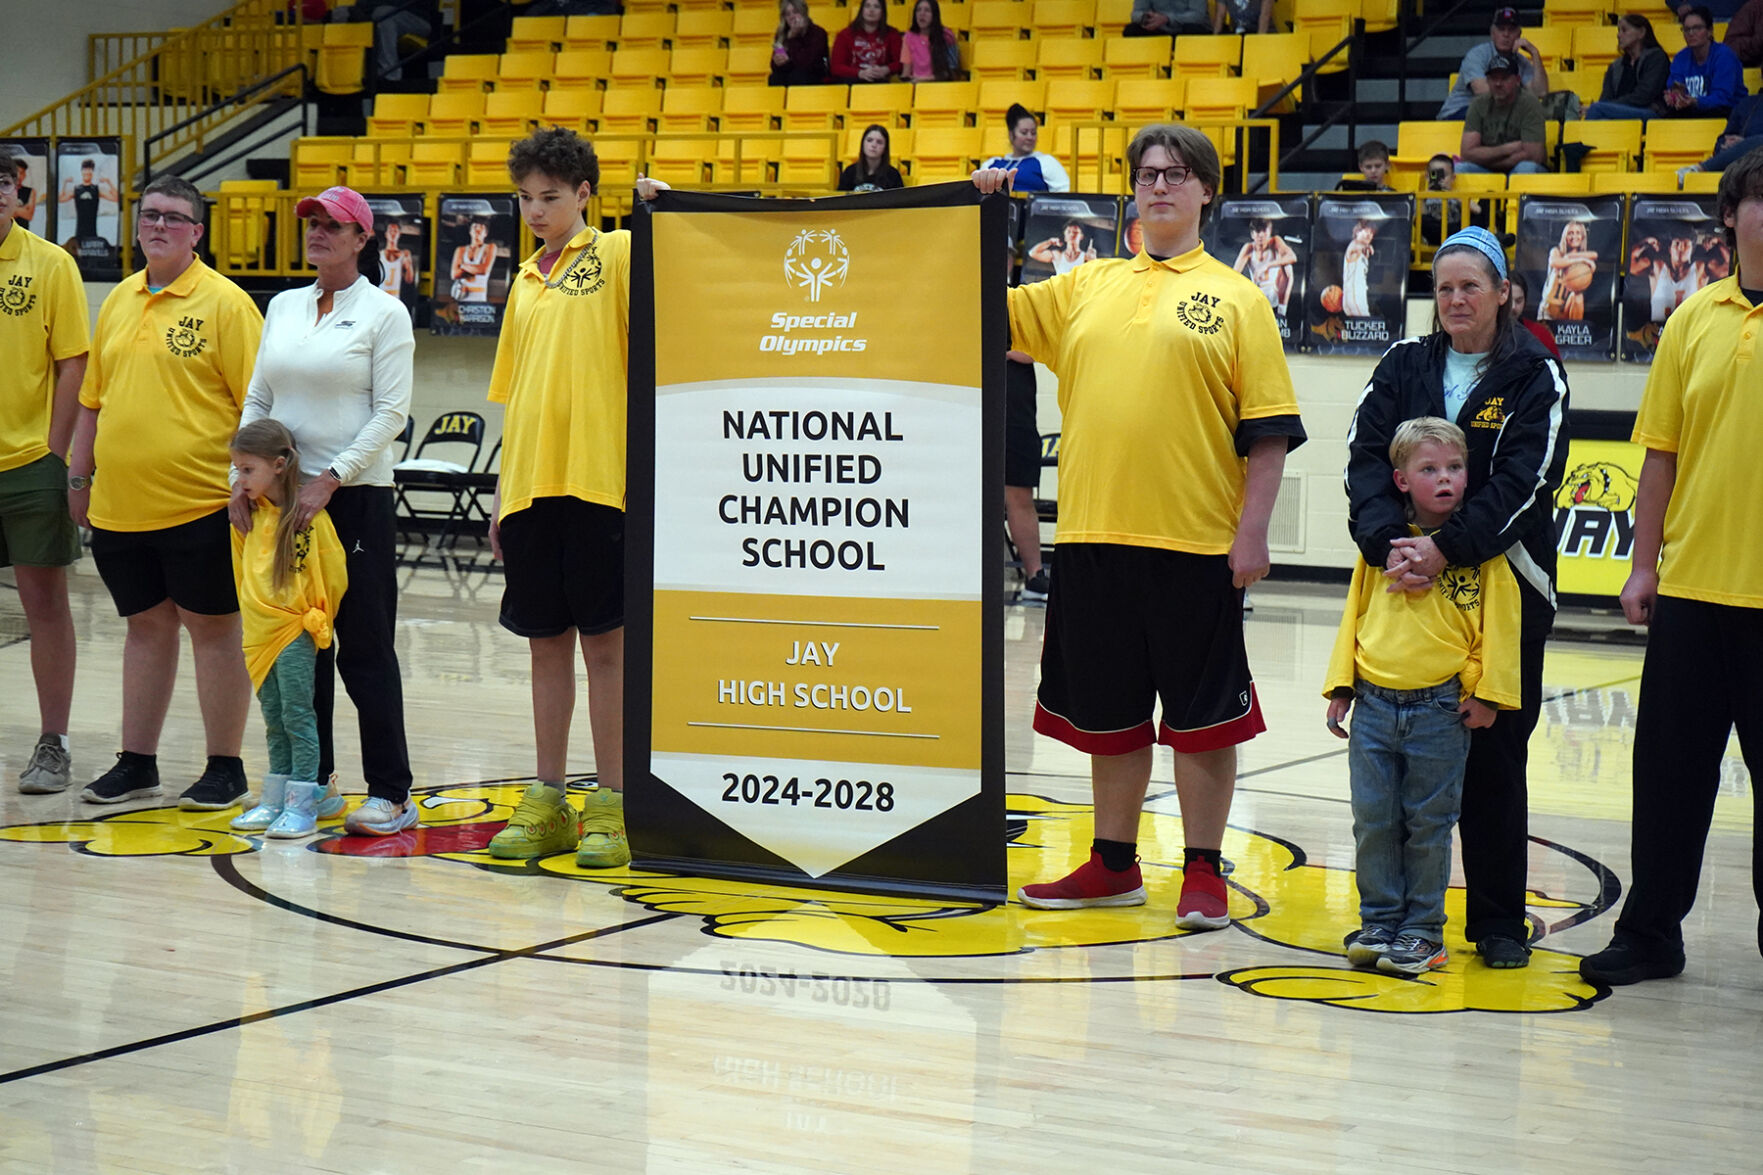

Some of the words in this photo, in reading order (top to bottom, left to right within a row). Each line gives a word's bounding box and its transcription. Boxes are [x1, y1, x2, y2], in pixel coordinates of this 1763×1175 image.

[8, 275, 32, 288] JAY
[581, 278, 605, 296] SPORTS
[1191, 291, 1221, 308] JAY
[178, 316, 204, 331] JAY
[771, 312, 858, 332] Special
[1176, 301, 1197, 330] UNIFIED
[1198, 316, 1224, 335] SPORTS
[1344, 320, 1386, 330] TUCKER
[1557, 324, 1590, 335] KAYLA
[166, 327, 182, 356] UNIFIED
[183, 338, 208, 357] SPORTS
[759, 335, 867, 356] Olympics
[1484, 396, 1504, 406] JAY
[434, 415, 477, 434] JAY
[723, 410, 904, 441] NATIONAL
[742, 453, 882, 484] UNIFIED
[718, 494, 909, 528] CHAMPION
[742, 537, 885, 571] SCHOOL
[786, 641, 840, 666] JAY
[718, 679, 785, 706] HIGH
[793, 683, 912, 713] SCHOOL
[722, 772, 895, 812] 2024-2028
